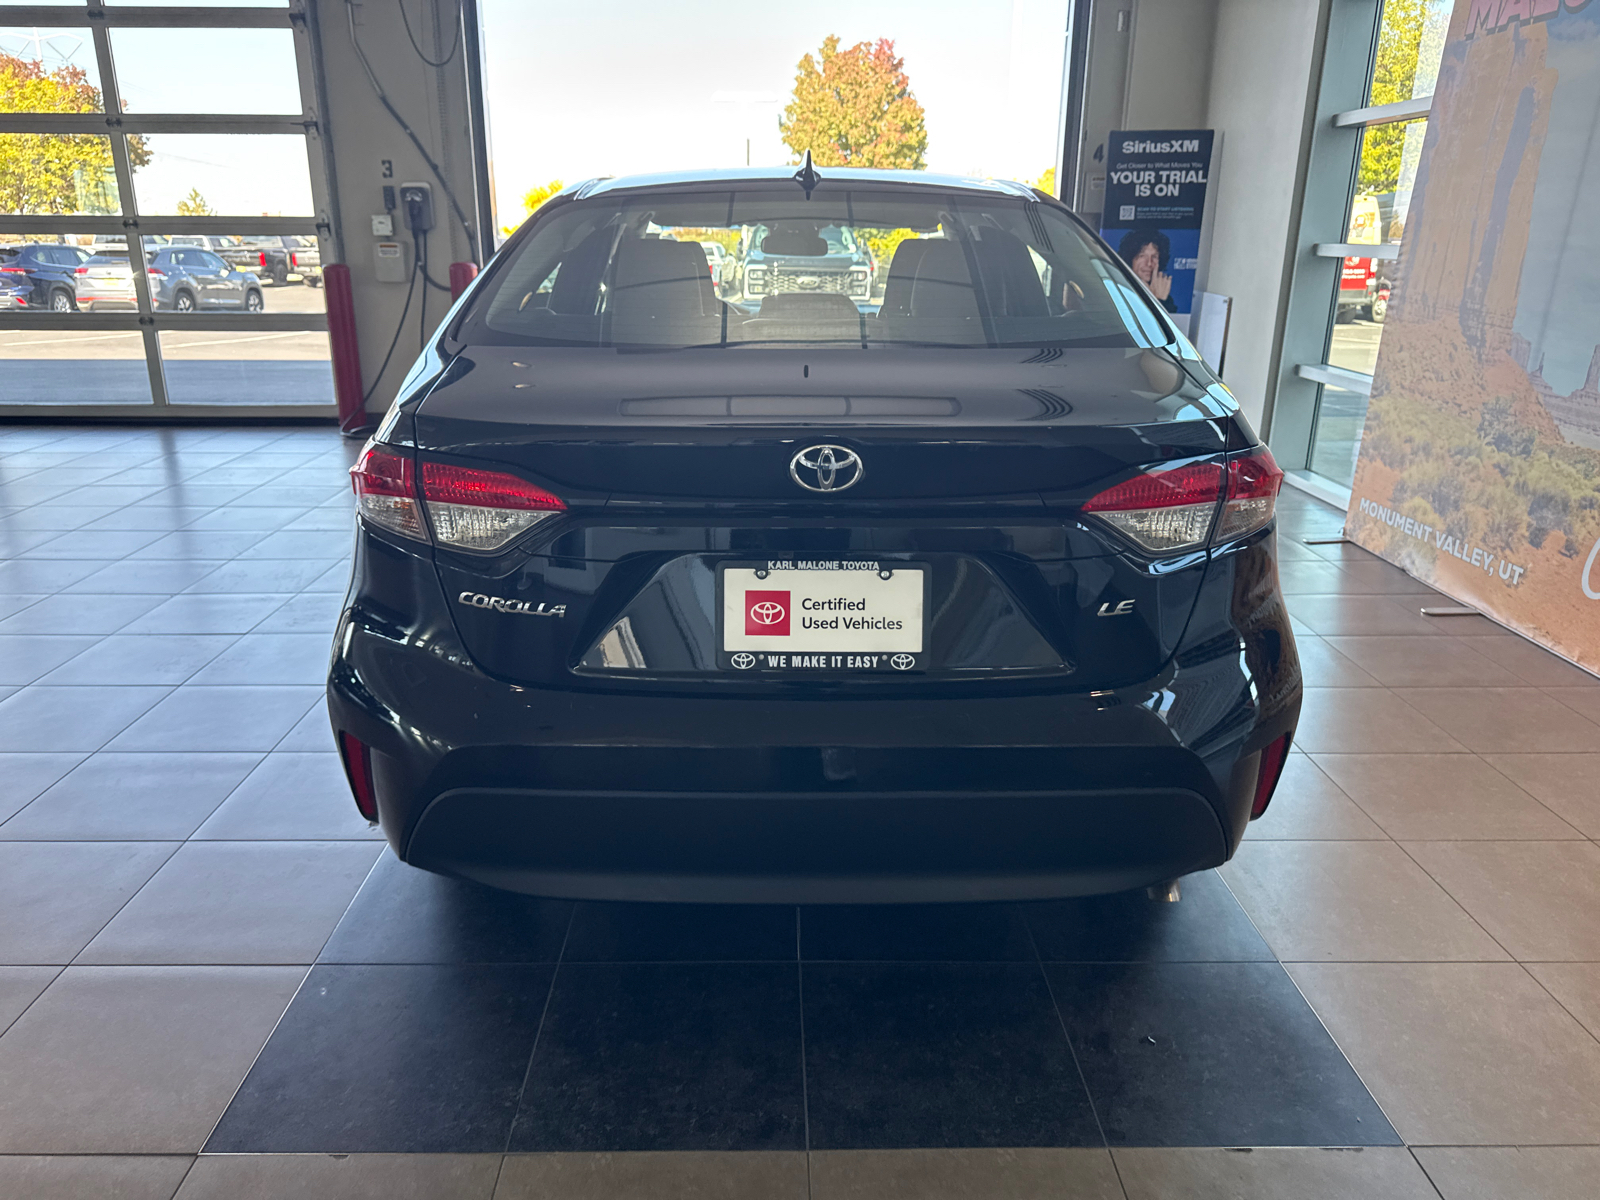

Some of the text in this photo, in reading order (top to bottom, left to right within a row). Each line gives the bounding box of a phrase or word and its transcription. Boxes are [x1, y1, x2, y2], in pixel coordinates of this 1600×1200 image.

[1093, 143, 1104, 163] 4
[1122, 140, 1199, 154] SiriusXM
[381, 159, 393, 178] 3
[1110, 170, 1207, 184] YOUR TRIAL
[1135, 184, 1180, 197] IS ON
[1359, 498, 1524, 585] MONUMENT VALLEY, UT
[768, 561, 879, 571] KARL MALONE TOYOTA
[458, 591, 567, 618] COROLLA
[802, 598, 866, 611] Certified
[1097, 599, 1136, 617] LE
[802, 617, 903, 630] Used Vehicles
[768, 655, 878, 668] WE MAKE IT EASY
